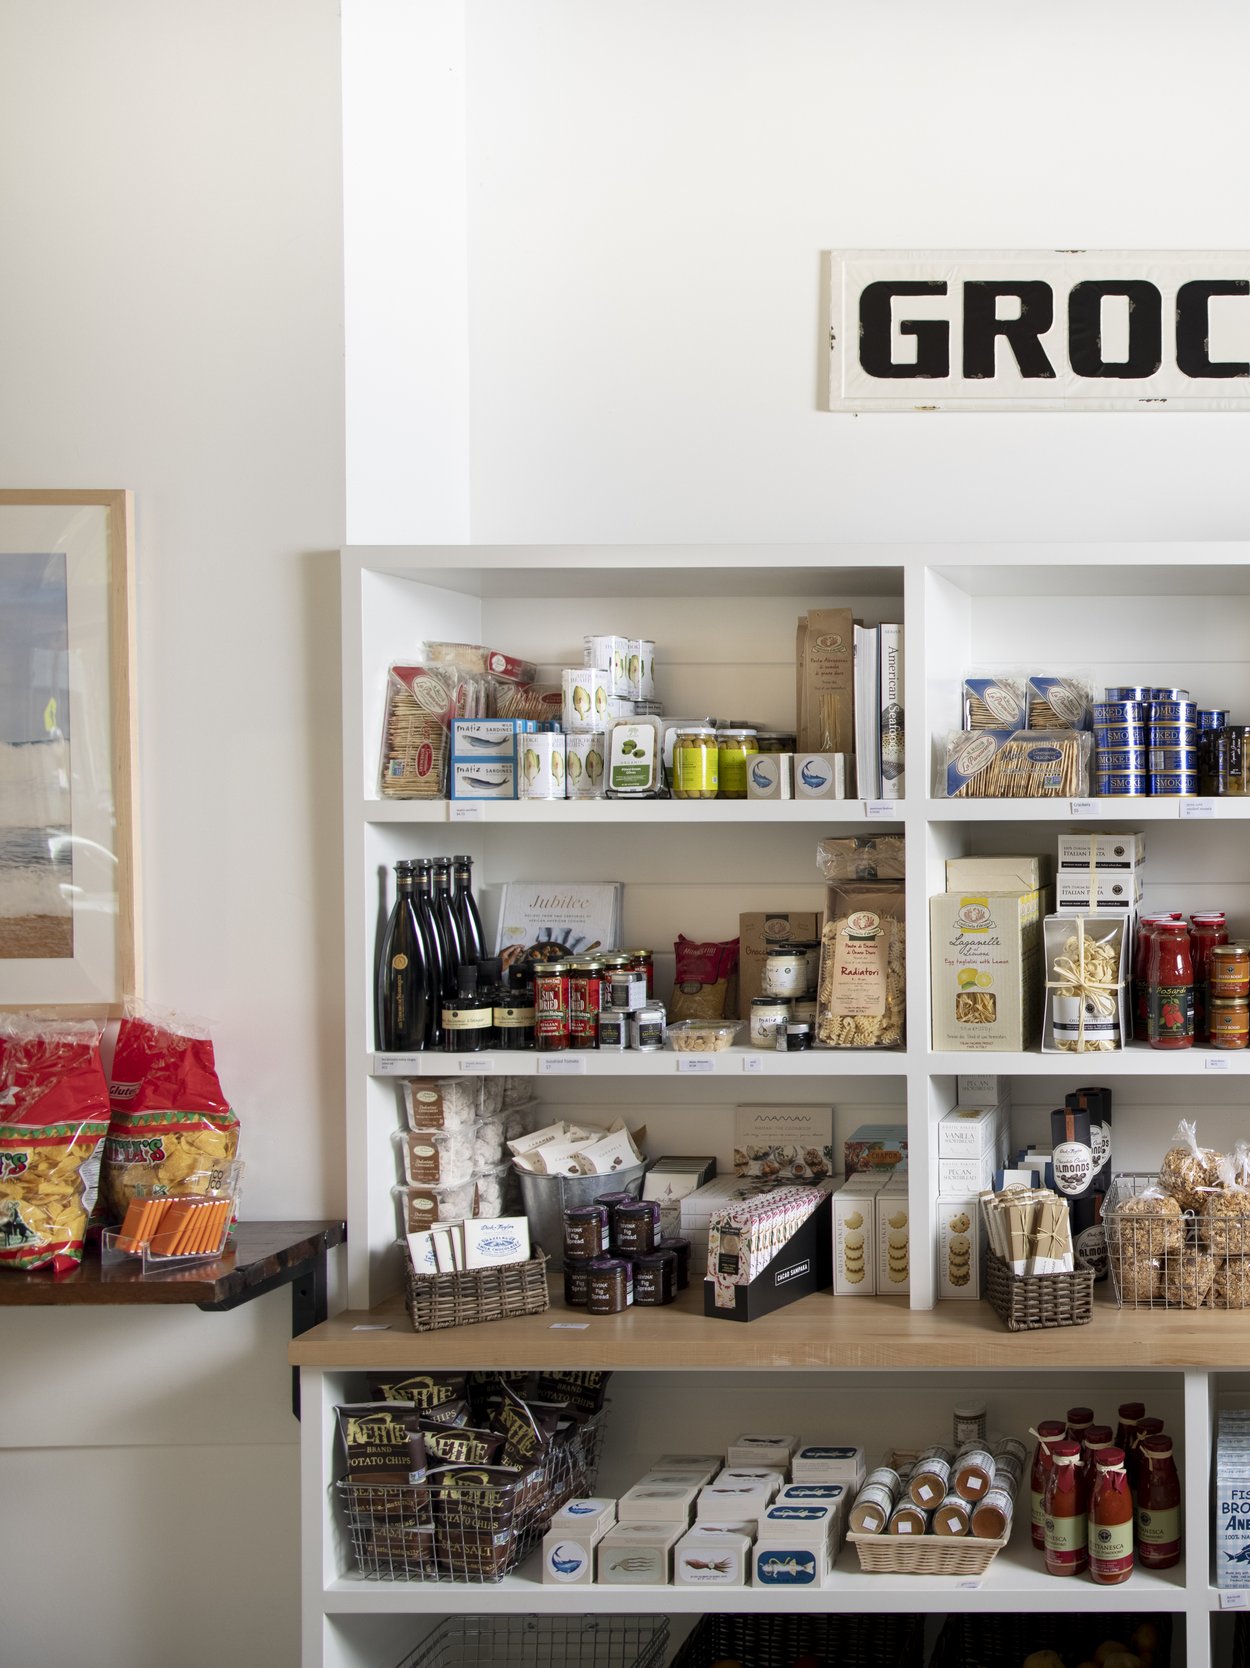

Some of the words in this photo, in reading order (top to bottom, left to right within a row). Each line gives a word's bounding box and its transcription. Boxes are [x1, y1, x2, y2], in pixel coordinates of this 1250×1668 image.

[888, 646, 899, 700] American
[888, 705, 899, 752] Seafood
[529, 895, 590, 909] Jubilee
[949, 933, 1001, 955] Laganelle
[841, 966, 879, 977] Radiatori
[542, 990, 554, 1001] SUN
[540, 998, 558, 1010] DRIED
[945, 1131, 975, 1139] VANILLA
[1055, 1162, 1090, 1174] ALMONDS
[347, 1412, 411, 1445] KETTLE
[367, 1446, 392, 1454] BRAND
[386, 1456, 411, 1466] CHIPS
[465, 1546, 493, 1556] SALT
